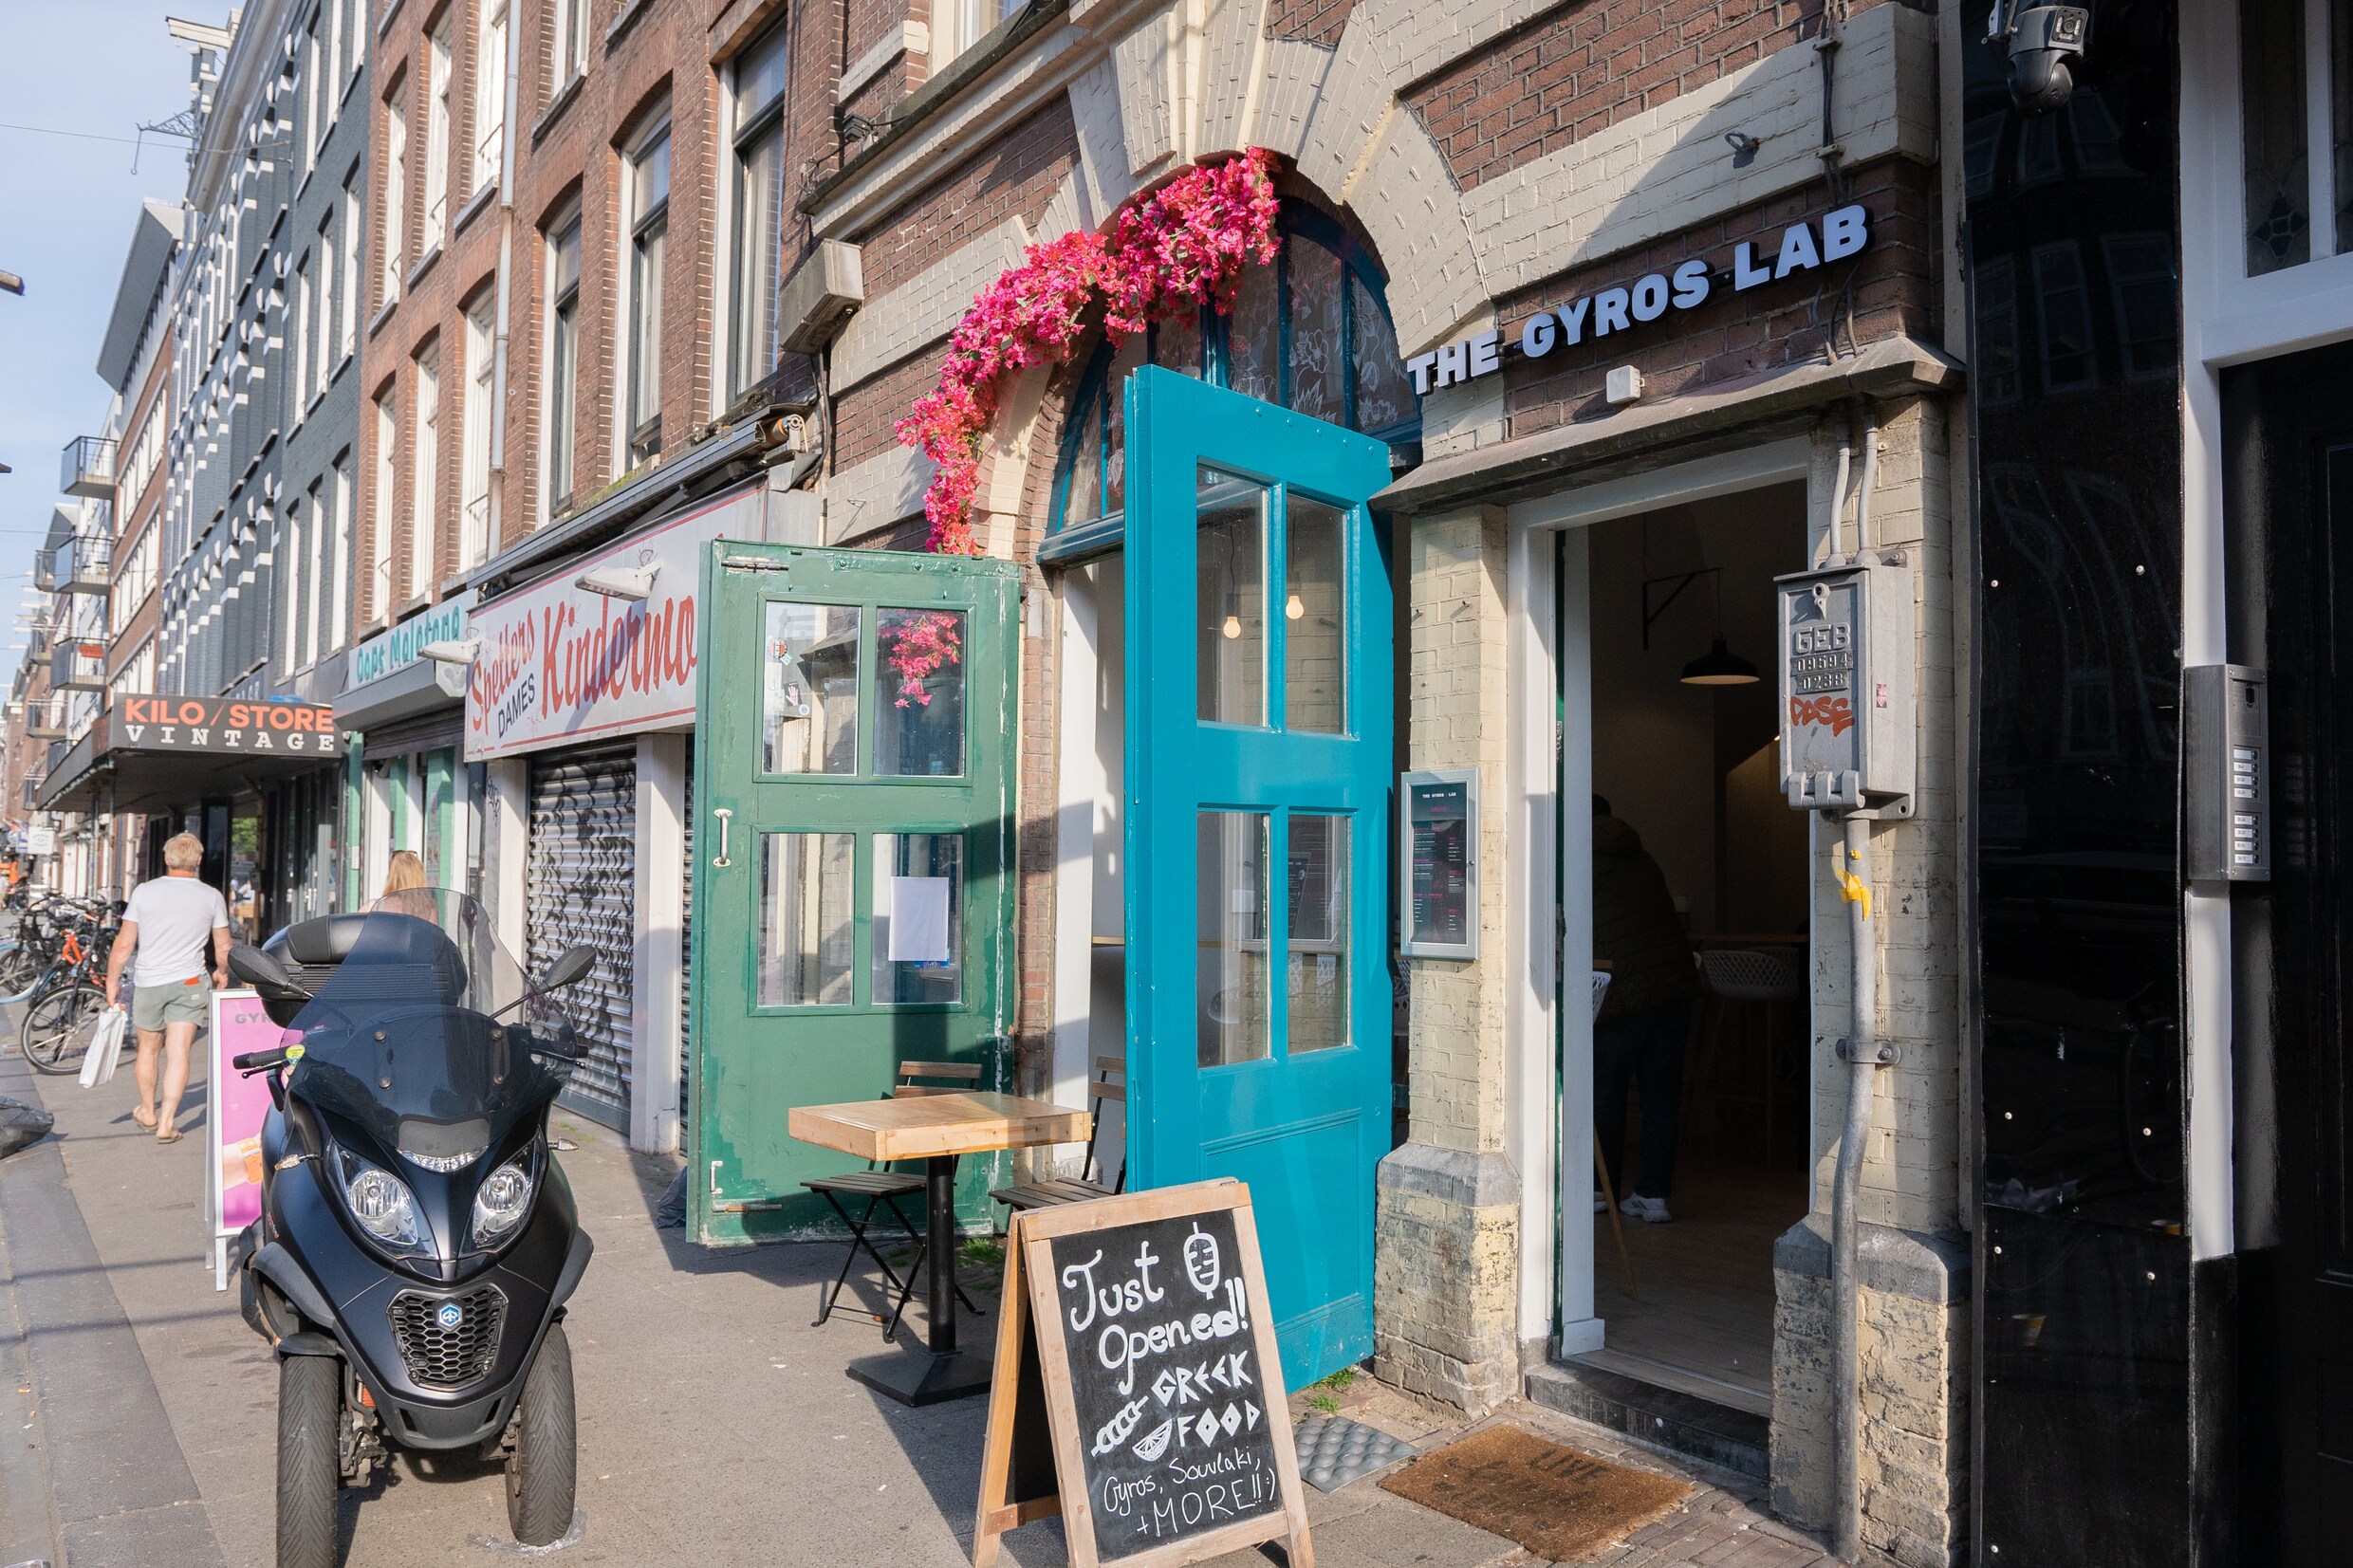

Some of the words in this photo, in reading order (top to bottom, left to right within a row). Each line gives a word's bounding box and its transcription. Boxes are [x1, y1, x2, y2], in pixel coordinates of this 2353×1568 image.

[1407, 329, 1503, 396] THE
[1522, 259, 1712, 359] GYROS
[1734, 204, 1871, 291] LAB
[357, 643, 385, 684] Oops
[471, 608, 535, 736] Spetters
[541, 594, 698, 720] Kindermo
[1794, 621, 1852, 655] GEB
[124, 698, 205, 725] KILO
[228, 704, 335, 732] STORE
[497, 673, 536, 740] DAMES
[125, 725, 335, 752] VINTAGE
[234, 1012, 272, 1024] GYR
[1062, 1240, 1164, 1333] Just
[1098, 1277, 1249, 1395] Opened!
[1150, 1350, 1253, 1408] GREEK
[1177, 1399, 1261, 1448] FOOD
[1103, 1474, 1163, 1517] Gyros,
[1168, 1446, 1261, 1485] Souvlaki,
